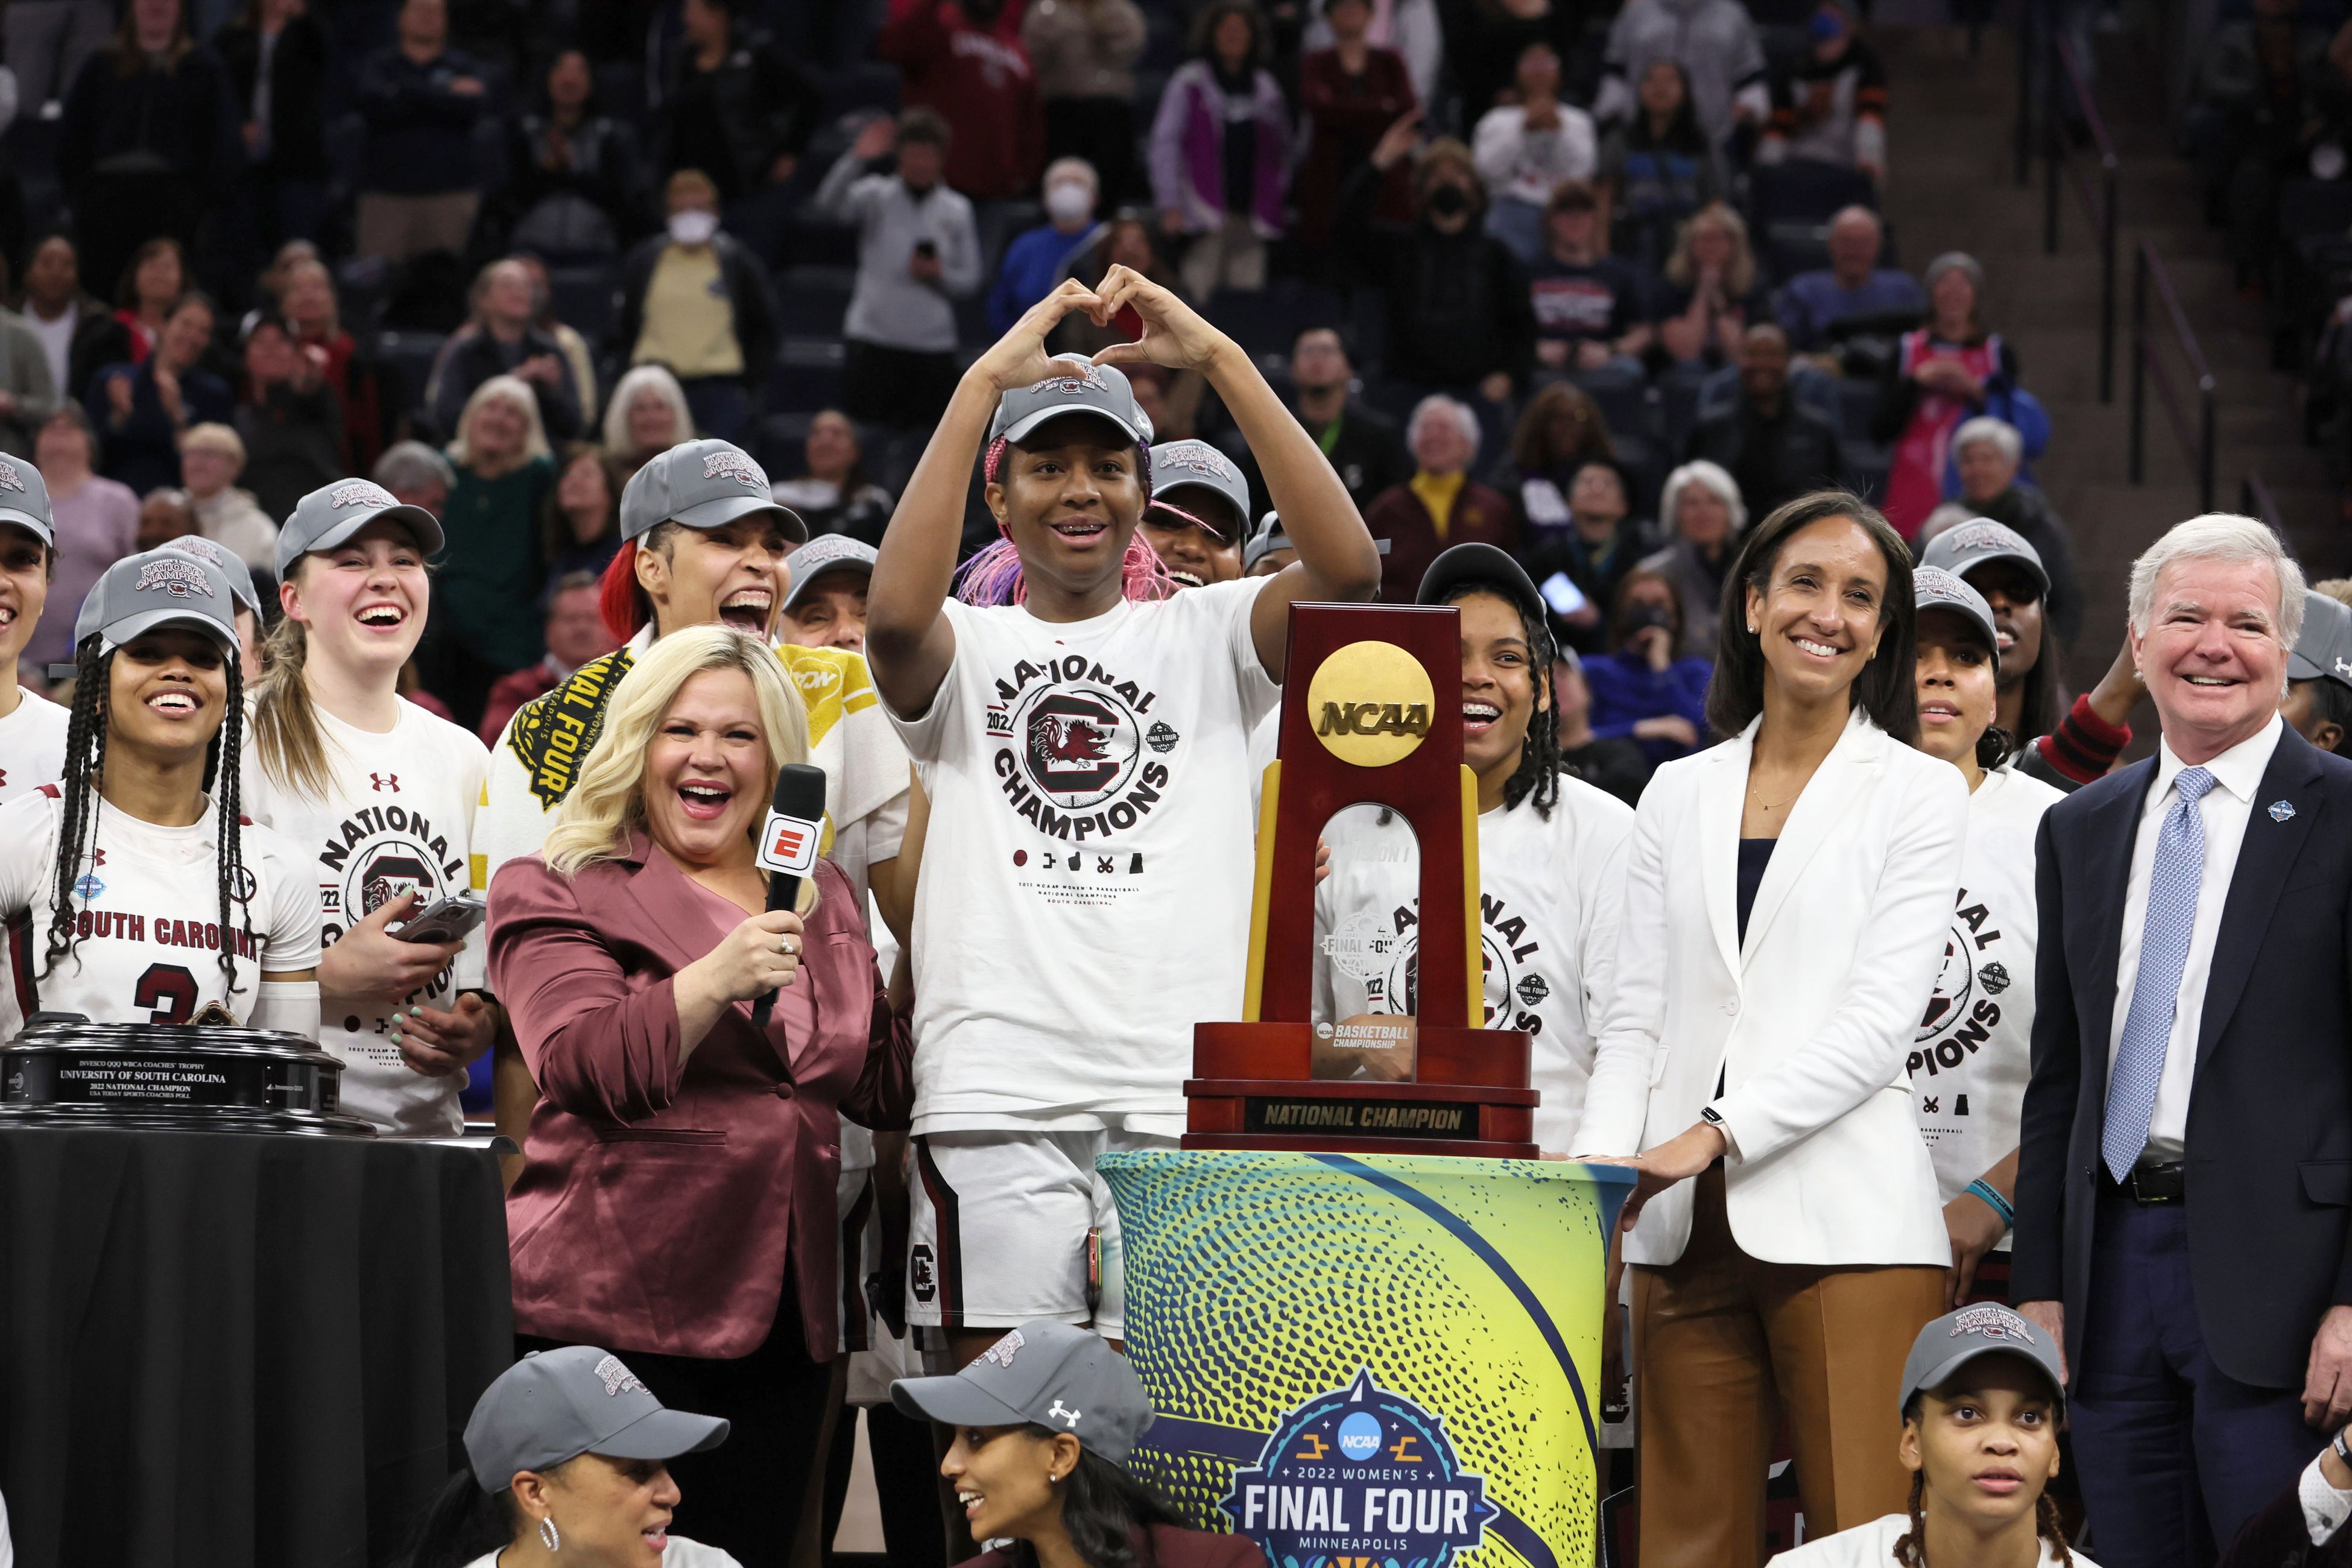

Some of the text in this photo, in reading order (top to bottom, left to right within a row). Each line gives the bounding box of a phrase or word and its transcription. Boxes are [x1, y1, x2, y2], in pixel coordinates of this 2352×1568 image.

[141, 563, 206, 581] NATIONAL
[136, 572, 213, 597] CHAMPIONS
[793, 671, 838, 690] NCA
[987, 712, 1011, 731] 202
[1317, 700, 1430, 739] NCAA
[539, 711, 586, 792] FOUR
[994, 748, 1169, 841] CHAMPIONS
[319, 806, 464, 882] NATIONAL
[1327, 938, 1364, 953] FINAL
[1979, 972, 2008, 986] FINAL FOUR
[1335, 1025, 1408, 1039] BASKETBALL
[1333, 1038, 1396, 1049] CHAMPIONSHIP
[60, 1070, 226, 1083] UNIVERSITY OF SOUTH CAROLINA
[1265, 1104, 1462, 1130] NATIONAL CHAMPION
[1341, 1435, 1381, 1449] NCAA
[1298, 1467, 1418, 1481] 2022 WOMEN'S
[1244, 1484, 1468, 1534] FINAL FOUR
[1298, 1537, 1408, 1551] MINNEAPOLIS
